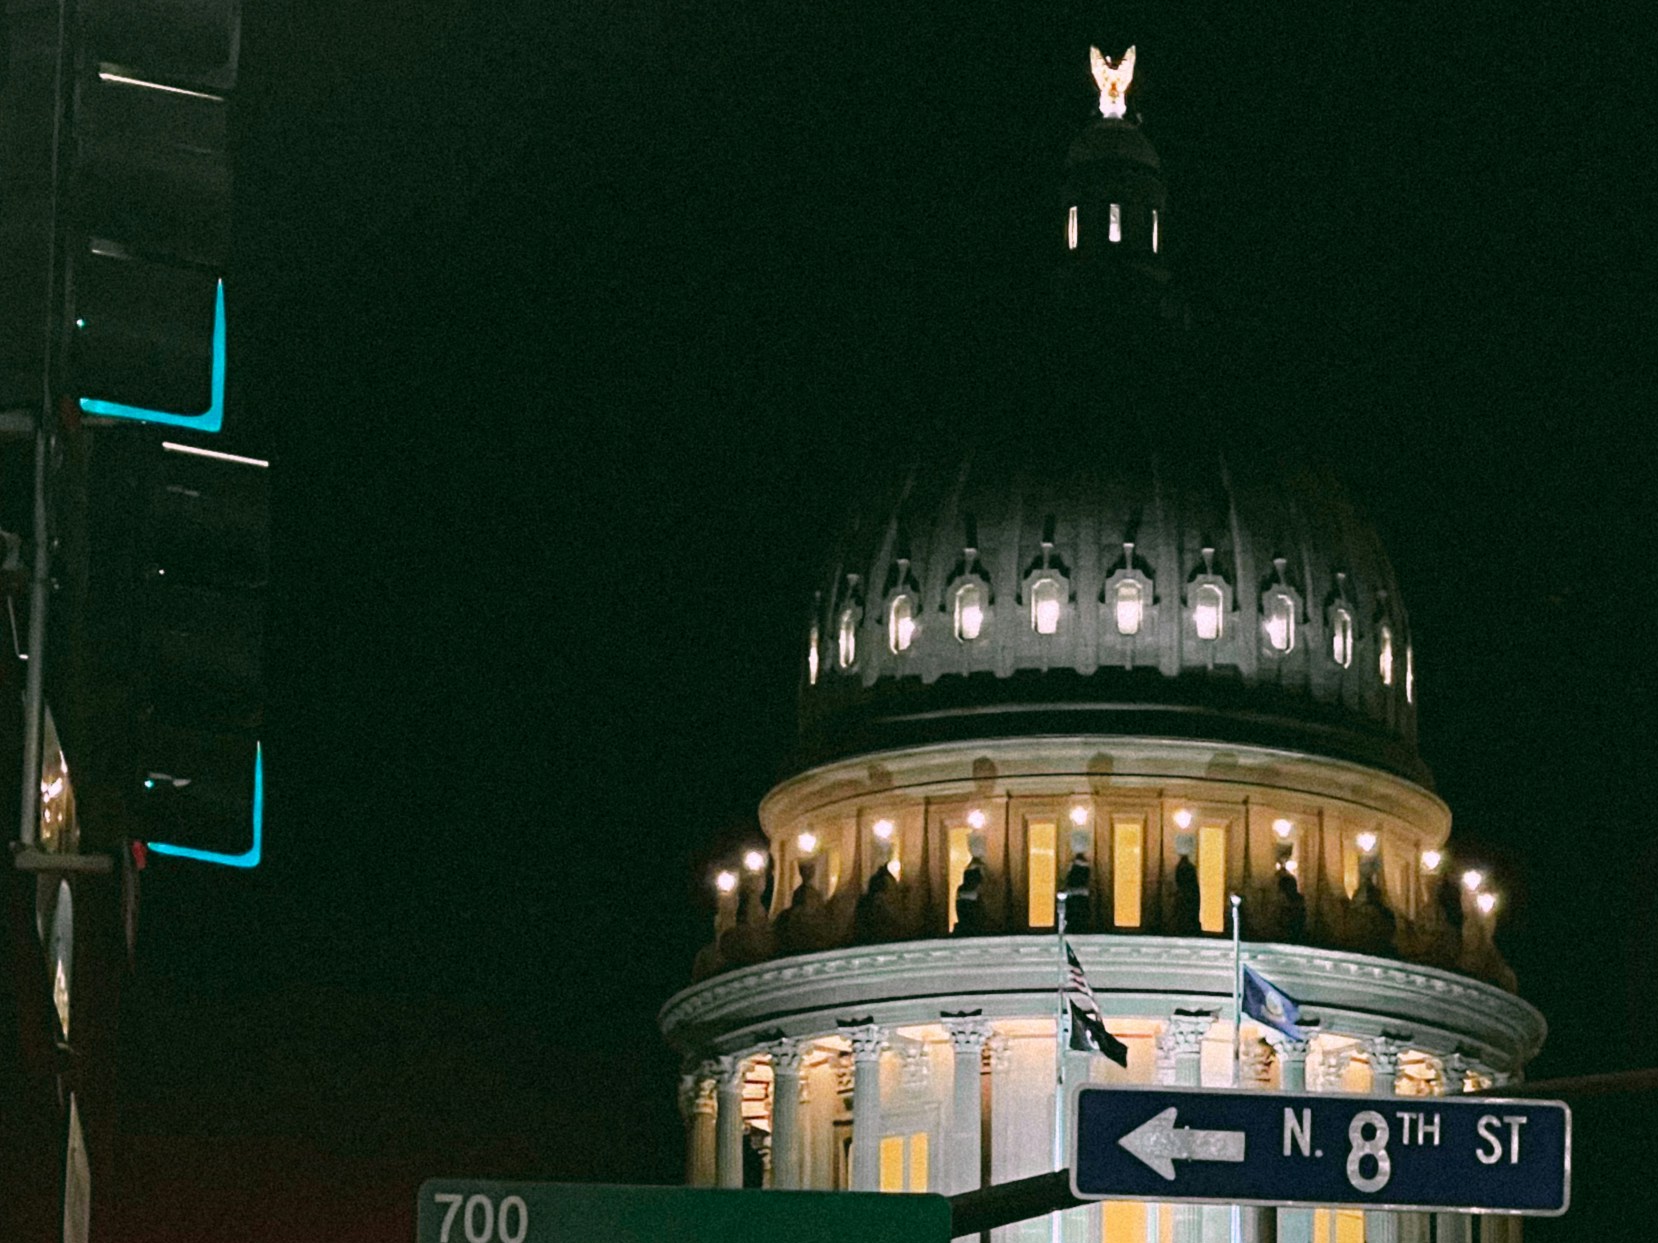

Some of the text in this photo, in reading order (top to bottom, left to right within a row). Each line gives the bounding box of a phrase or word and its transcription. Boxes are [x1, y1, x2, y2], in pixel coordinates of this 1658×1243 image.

[1282, 1107, 1528, 1193] N. 8TH ST
